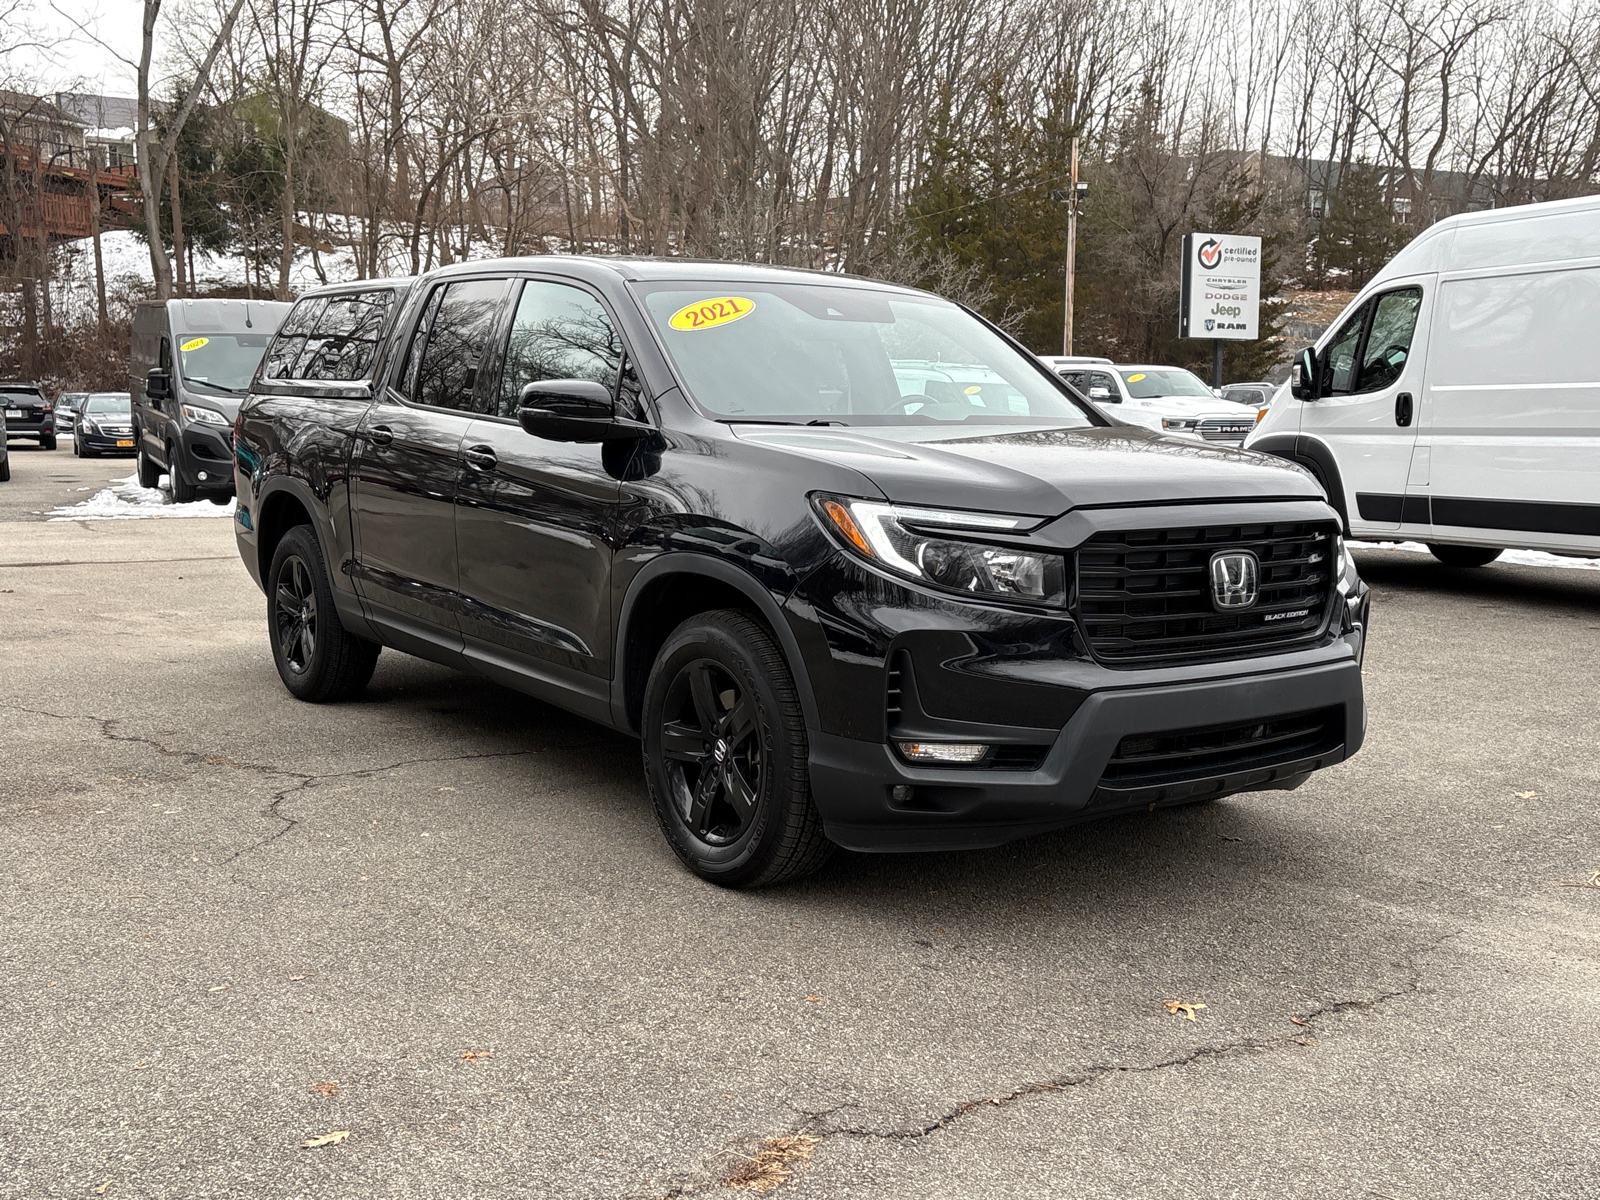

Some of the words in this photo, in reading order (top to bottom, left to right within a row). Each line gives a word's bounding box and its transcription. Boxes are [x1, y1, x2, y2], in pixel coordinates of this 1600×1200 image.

[1224, 247, 1257, 256] certified
[1205, 292, 1248, 301] DODGE
[685, 299, 744, 327] 2021
[1211, 302, 1242, 318] Jeep
[1216, 322, 1247, 330] RAM
[1264, 612, 1286, 621] BLACK
[1286, 609, 1309, 619] EDITION
